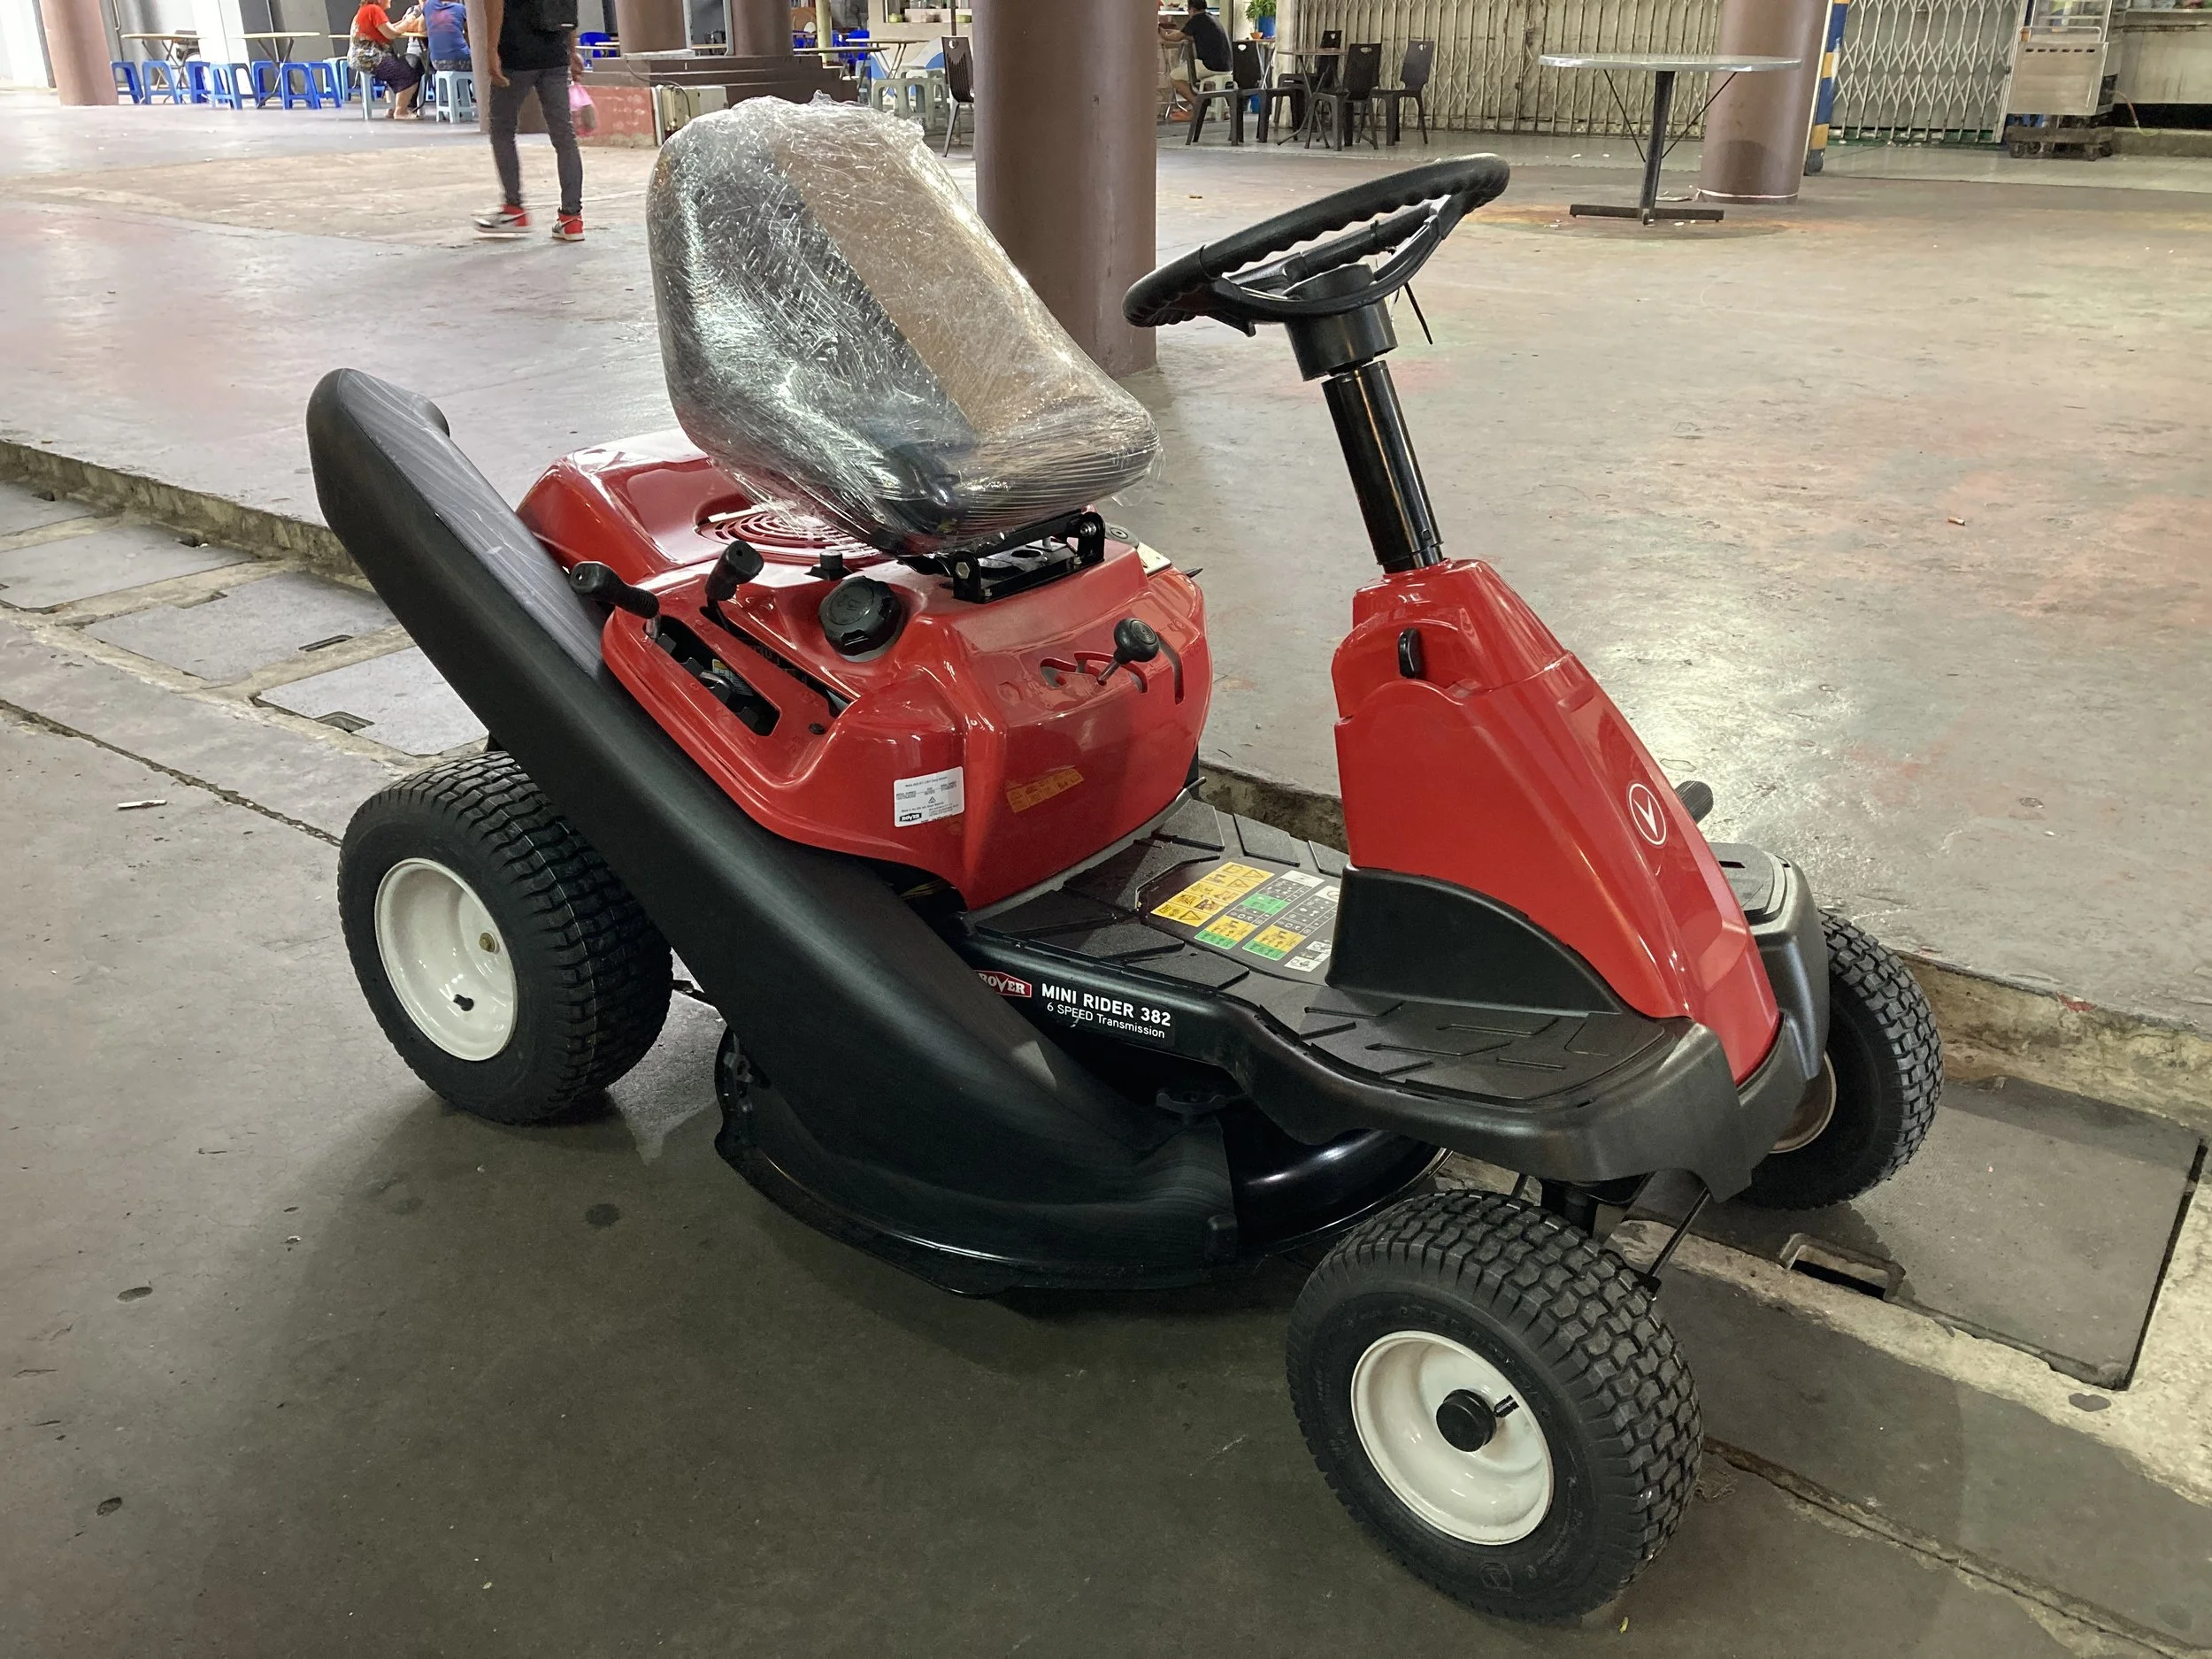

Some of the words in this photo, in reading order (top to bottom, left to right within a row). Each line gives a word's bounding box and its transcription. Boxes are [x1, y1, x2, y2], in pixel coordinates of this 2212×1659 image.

[1041, 982, 1077, 1005] MINI
[1083, 993, 1134, 1018] RIDER
[1140, 1007, 1171, 1027] 382
[1047, 1002, 1054, 1012] 6
[1056, 1003, 1094, 1022] SPEED
[1096, 1012, 1165, 1039] Transmission
